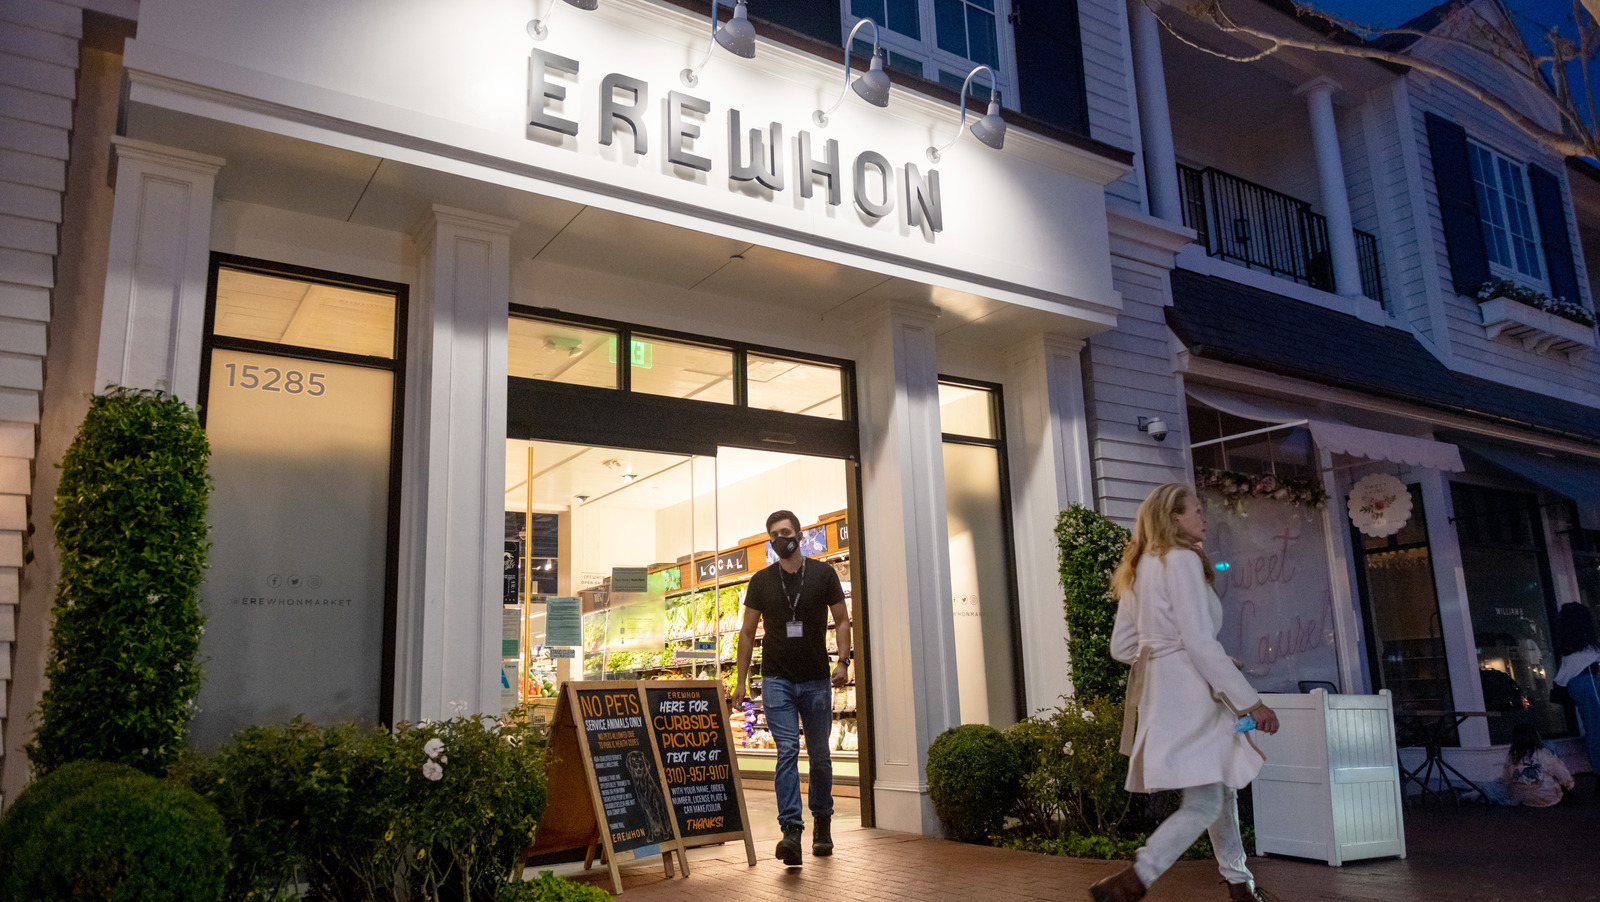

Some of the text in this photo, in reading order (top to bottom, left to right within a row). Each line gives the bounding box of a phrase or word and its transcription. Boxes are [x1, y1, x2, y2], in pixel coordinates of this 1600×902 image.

[528, 47, 944, 234] EREWHON
[225, 362, 327, 397] 15285
[700, 558, 743, 576] LOCAL
[667, 691, 700, 699] EREWHON
[580, 693, 640, 718] NO PETS
[659, 700, 709, 713] HERE FOR
[585, 716, 643, 731] SERVICE ANIMALS ONLY
[653, 714, 719, 731] CURBSIDE
[661, 731, 718, 749] PICKUP?
[666, 749, 722, 764] TEXT US AT
[671, 783, 726, 795] WITH YOUR NAME, ORDER
[671, 793, 728, 805] NUMBER, LICENSE PLATE &
[683, 803, 722, 815] CAR MAKE/COLOR
[686, 815, 724, 831] THANKS!
[611, 827, 646, 843] EREWHON
